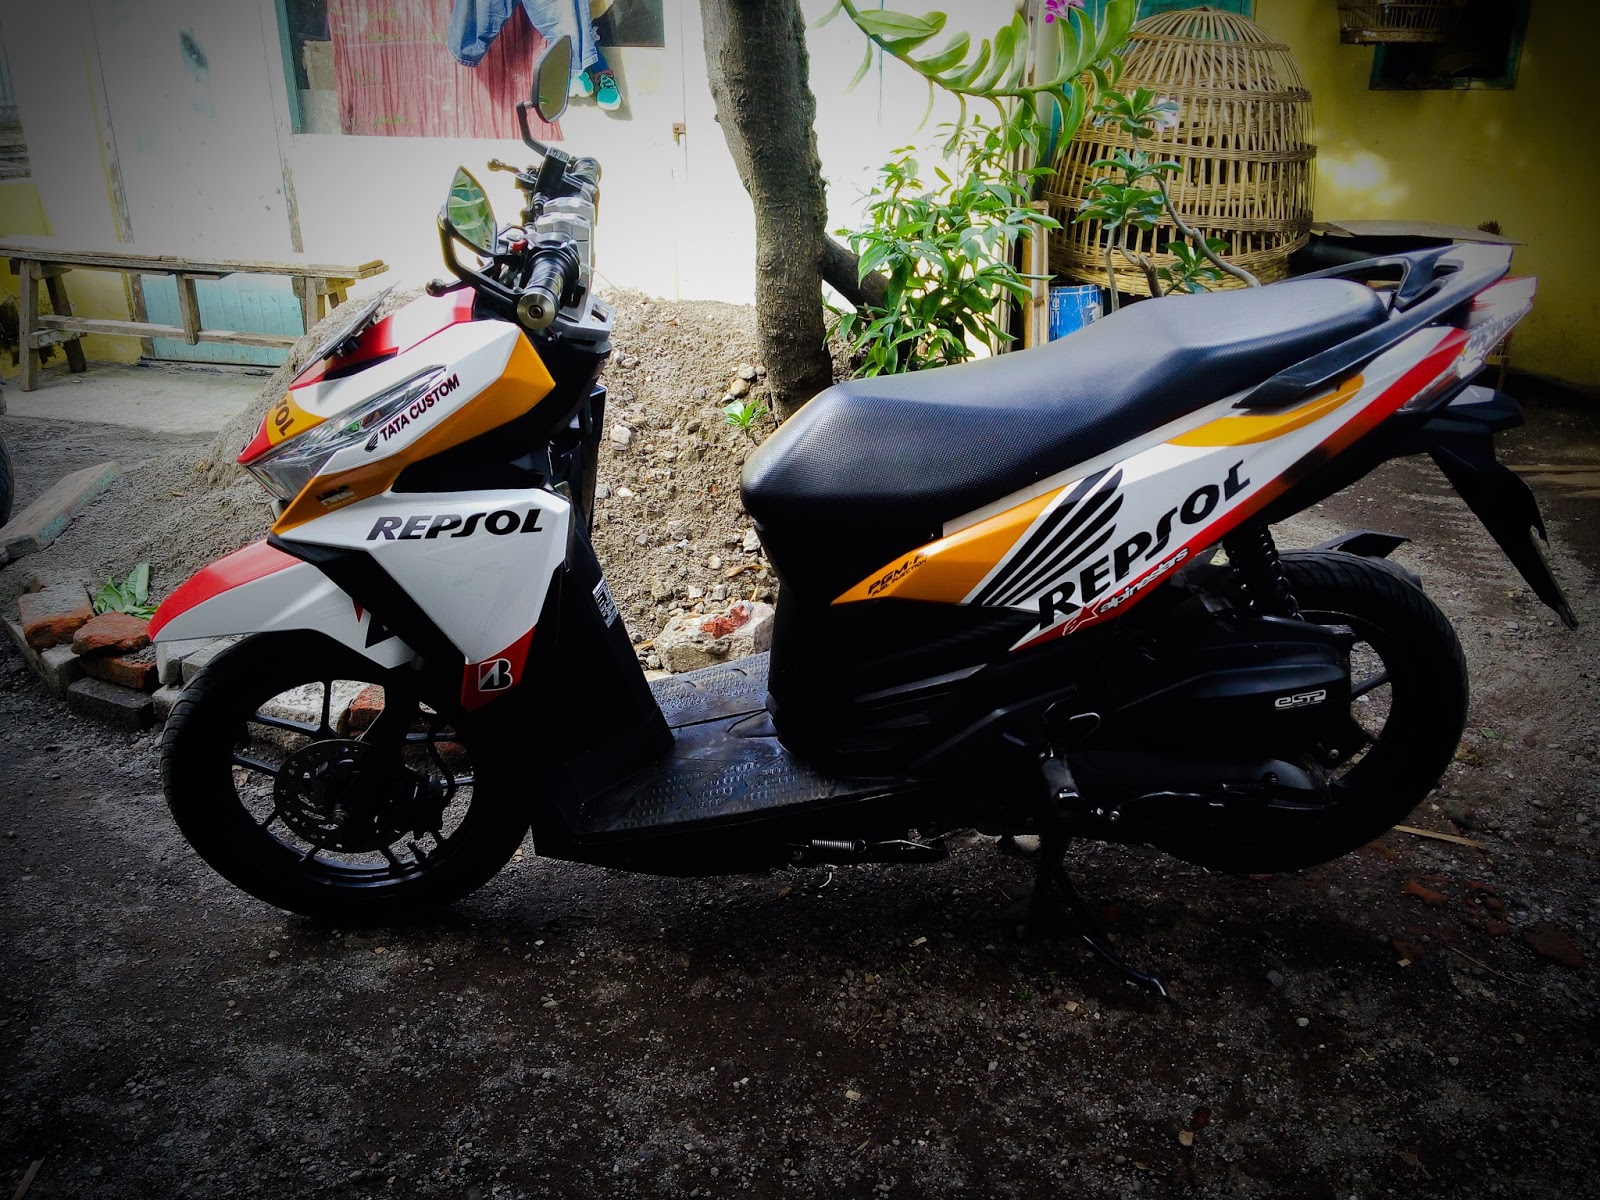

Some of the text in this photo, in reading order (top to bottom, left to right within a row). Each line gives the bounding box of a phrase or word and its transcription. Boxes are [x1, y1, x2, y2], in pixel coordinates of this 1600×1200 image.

[379, 373, 460, 441] TATA CUSTOM
[366, 508, 543, 541] REPSOL
[1038, 459, 1250, 631] REPSOL
